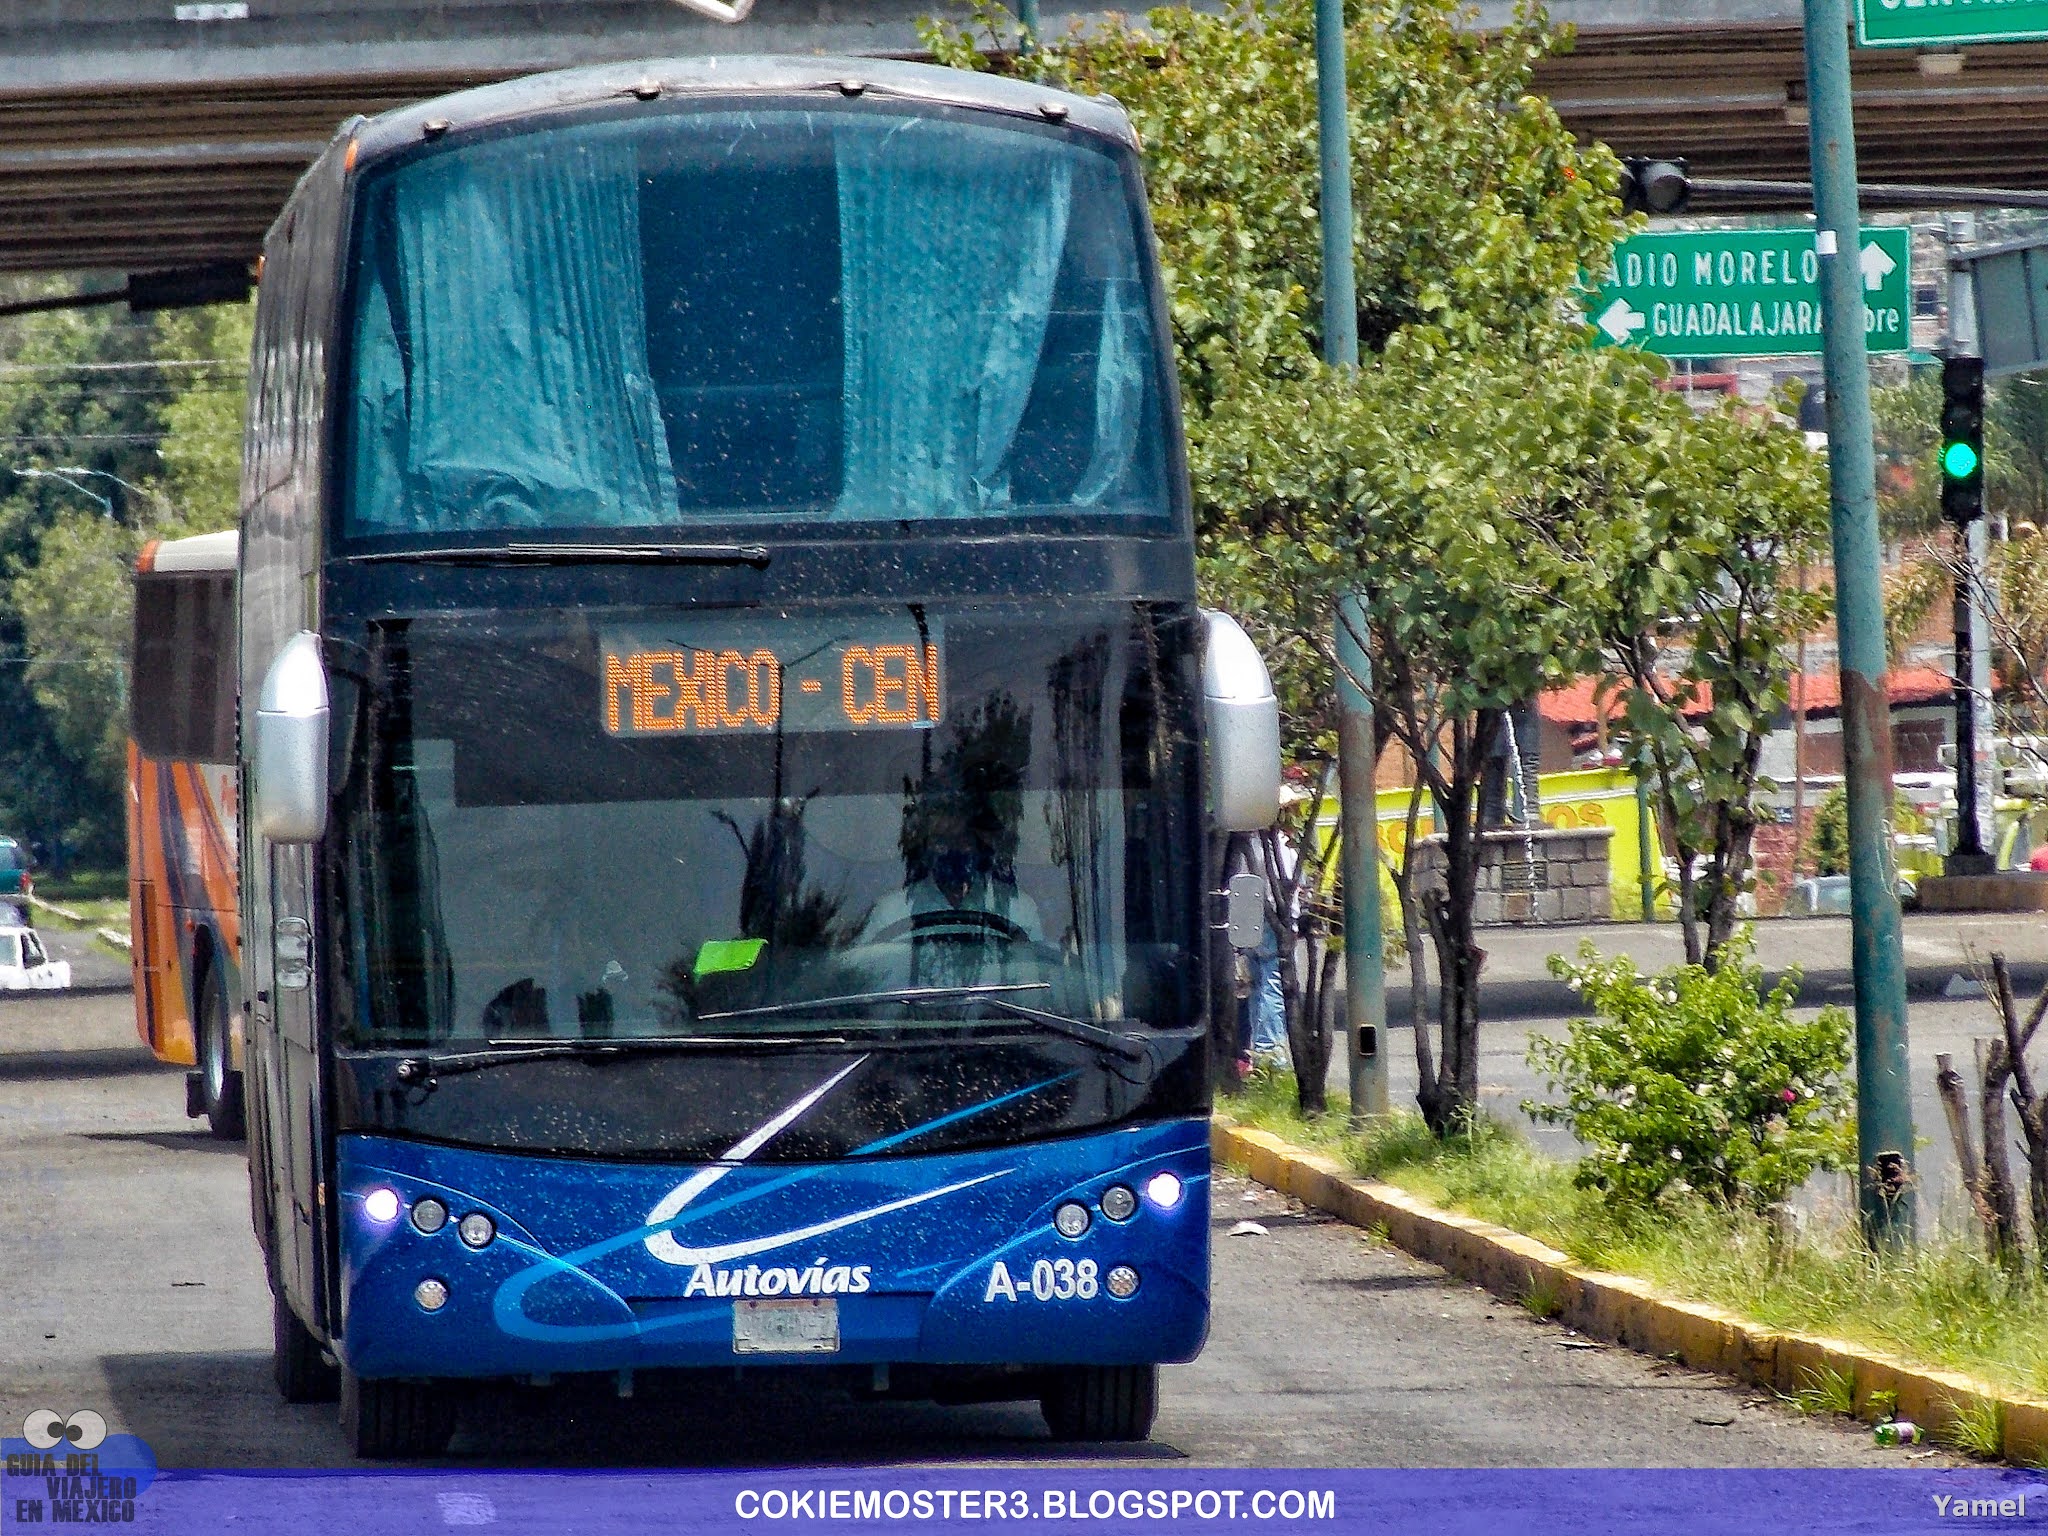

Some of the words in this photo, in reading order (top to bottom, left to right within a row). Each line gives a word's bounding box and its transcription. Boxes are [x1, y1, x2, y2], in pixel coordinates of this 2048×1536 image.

[1604, 249, 1678, 288] ADIO
[1694, 249, 1820, 286] MORELO
[606, 648, 781, 732] MEXICO
[842, 643, 940, 725] CEN
[683, 1257, 872, 1298] Autovías
[984, 1259, 1099, 1303] A-038
